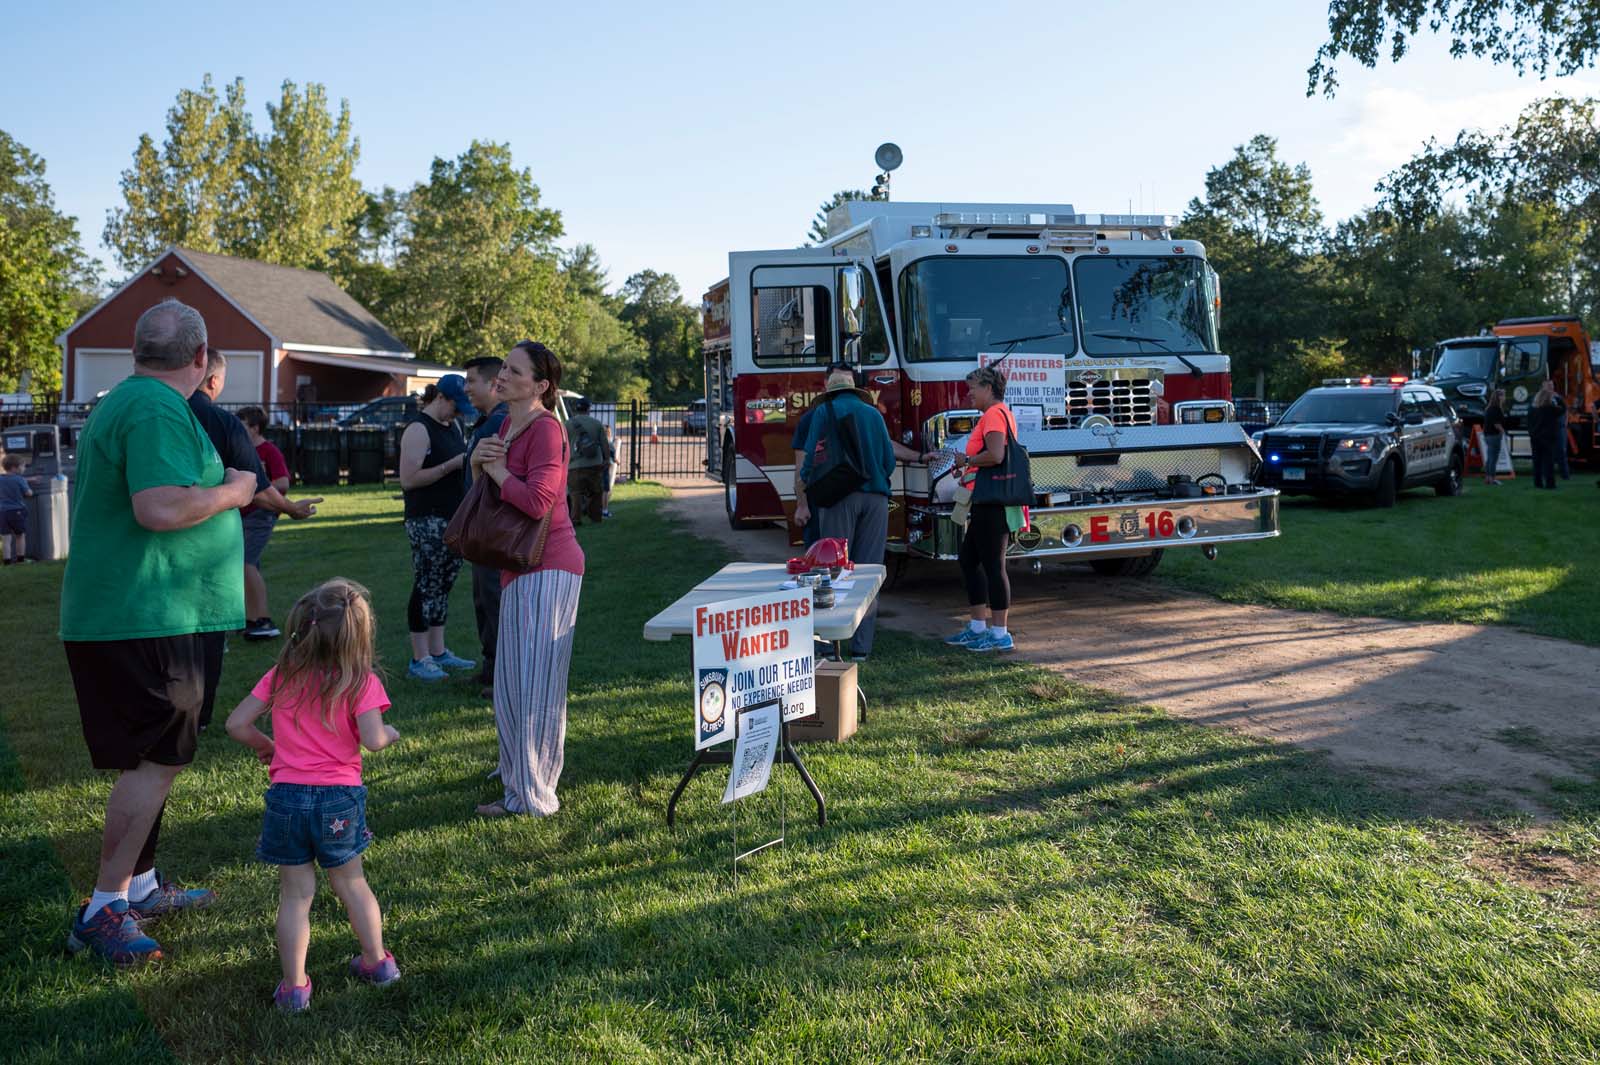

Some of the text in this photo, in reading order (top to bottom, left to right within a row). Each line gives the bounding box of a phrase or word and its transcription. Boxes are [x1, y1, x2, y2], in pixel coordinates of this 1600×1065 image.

[1000, 369, 1047, 381] WANTED
[1004, 387, 1064, 396] JOIN OUR TEAM!
[1090, 516, 1110, 542] E
[1145, 511, 1174, 538] 16
[696, 598, 811, 637] FIREFIGHTERS
[722, 629, 789, 661] WANTED
[732, 656, 812, 693] JOIN OUR TEAM!
[732, 677, 813, 710] NO EXPERIENCE NEEDED
